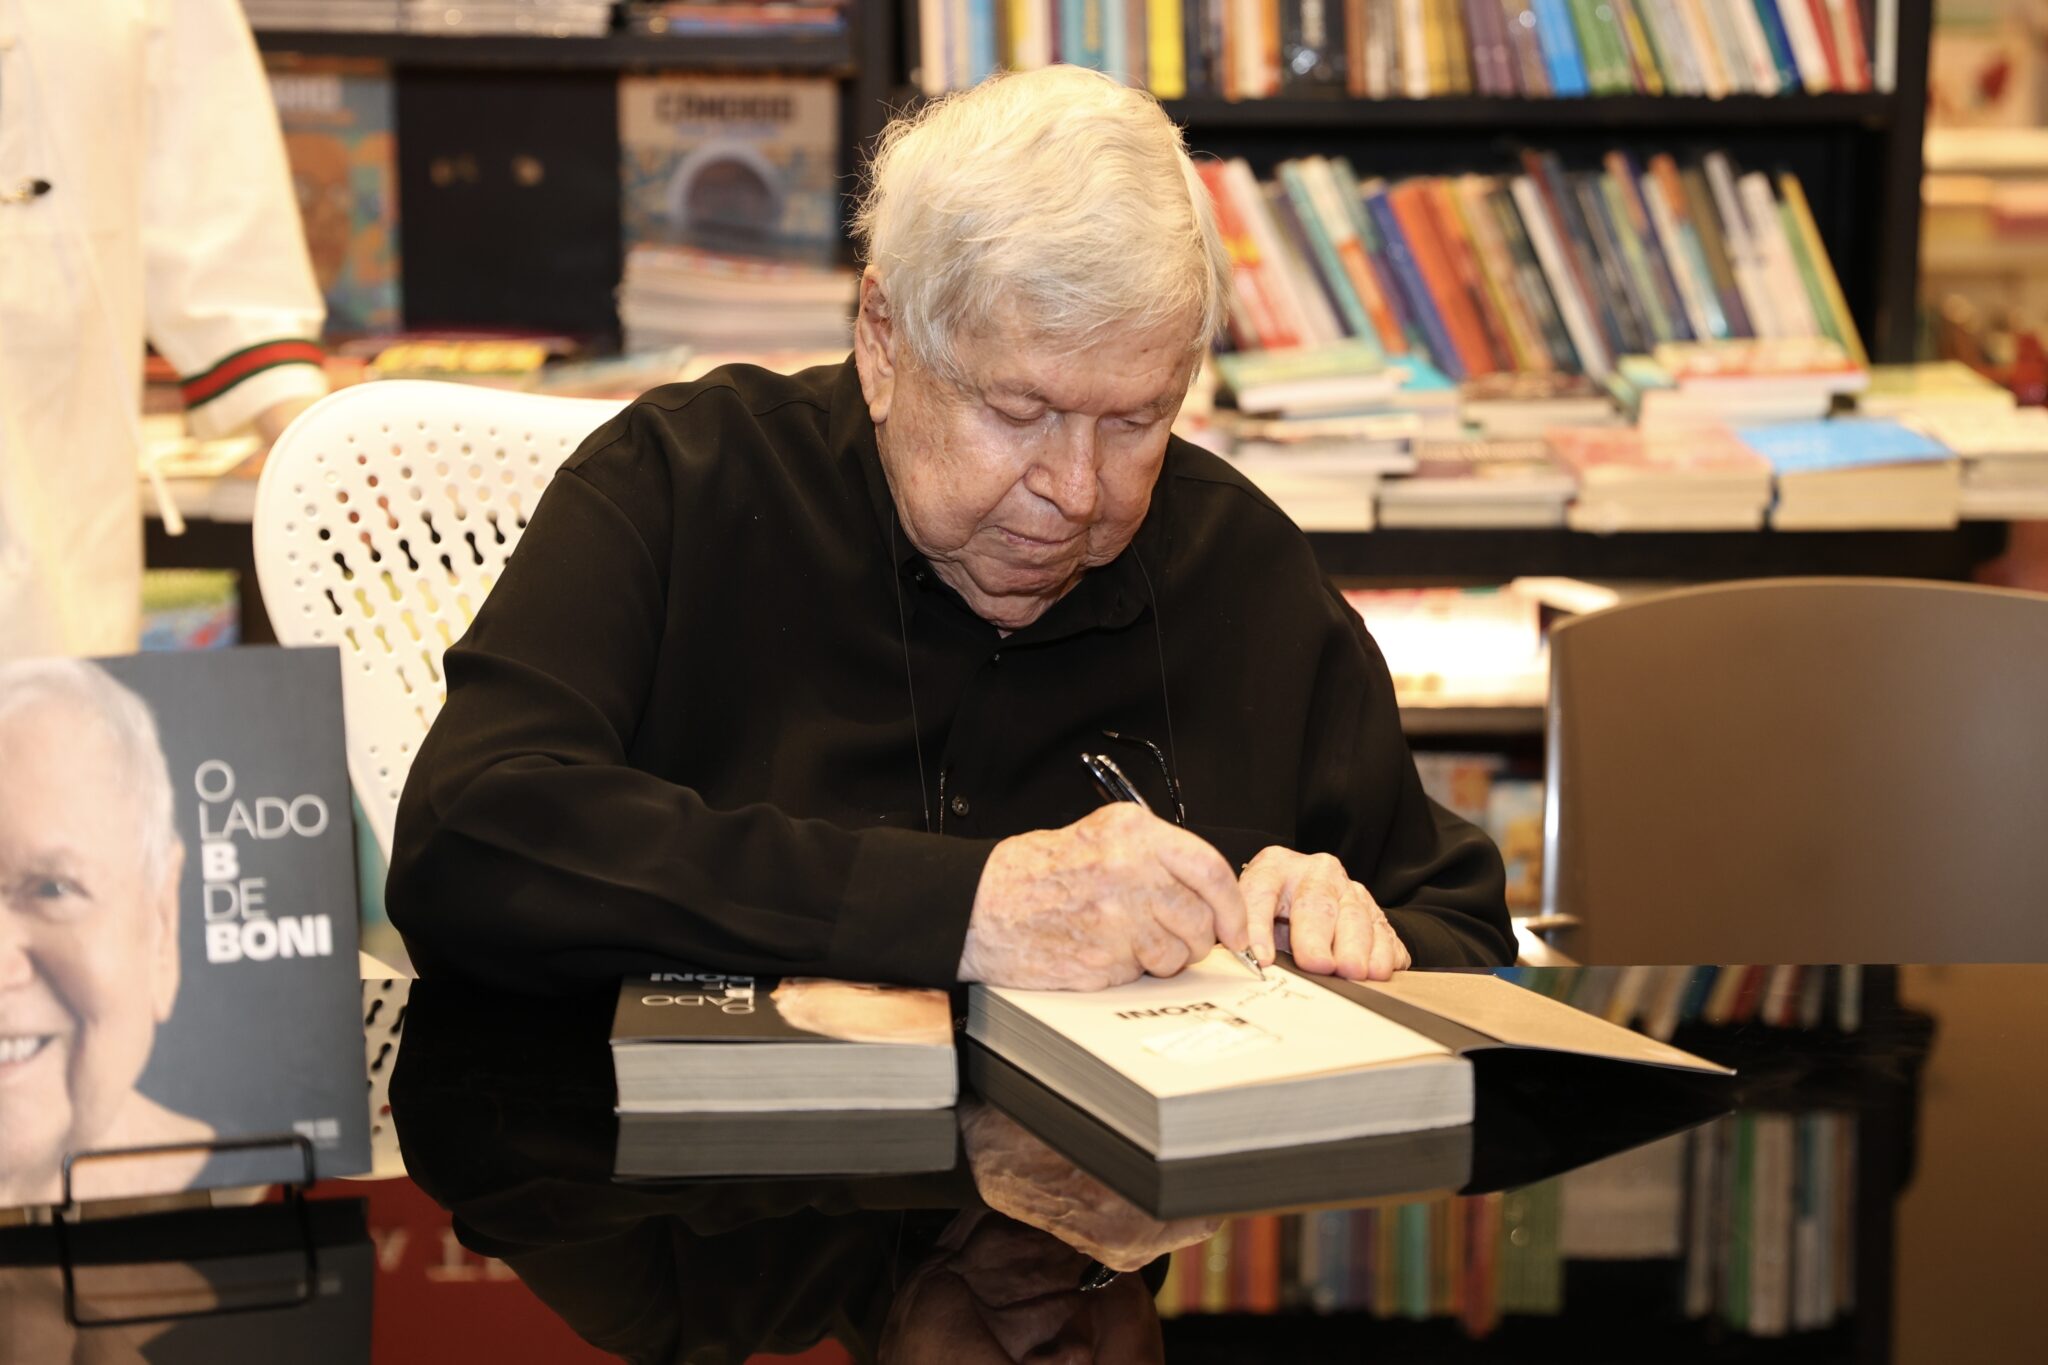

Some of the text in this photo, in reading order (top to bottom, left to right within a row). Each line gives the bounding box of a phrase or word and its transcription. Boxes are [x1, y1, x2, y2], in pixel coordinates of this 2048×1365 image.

[194, 760, 235, 801] O
[199, 794, 329, 842] LADO
[202, 842, 239, 881] B
[204, 877, 266, 921] DE
[205, 914, 332, 963] BONI
[1115, 1002, 1218, 1020] BONI
